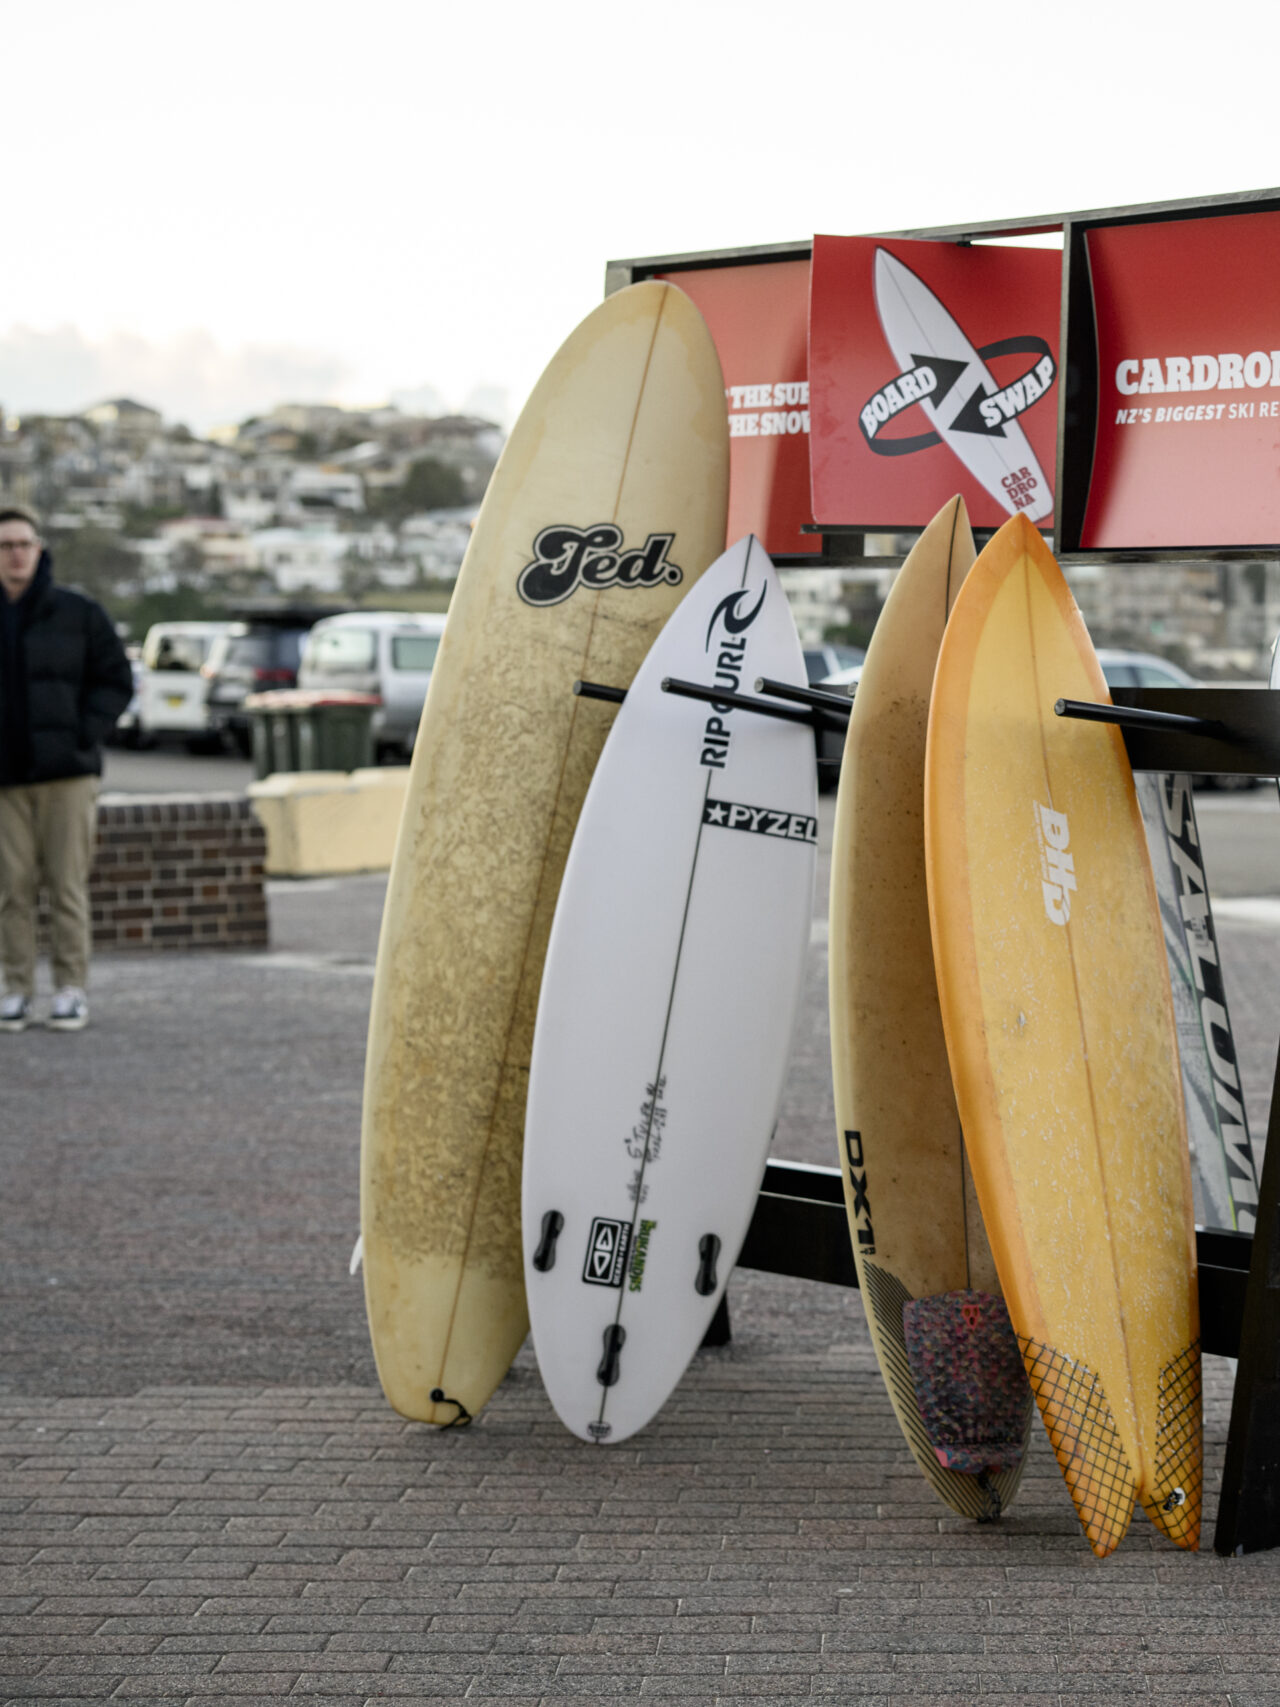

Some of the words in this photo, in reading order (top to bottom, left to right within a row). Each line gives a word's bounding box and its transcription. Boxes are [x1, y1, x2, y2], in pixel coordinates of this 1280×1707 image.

[730, 384, 773, 409] THE
[860, 366, 938, 439] BOARD
[979, 355, 1054, 428] SWAP
[1115, 408, 1152, 424] NZ'S
[1154, 404, 1225, 422] BIGGEST
[1228, 403, 1254, 419] SKI
[1001, 467, 1032, 489] CAR
[1006, 477, 1038, 500] DRO
[1012, 493, 1036, 510] NA
[700, 716, 731, 768] RIP
[727, 804, 818, 840] PYZEL
[844, 1130, 875, 1245] DX1
